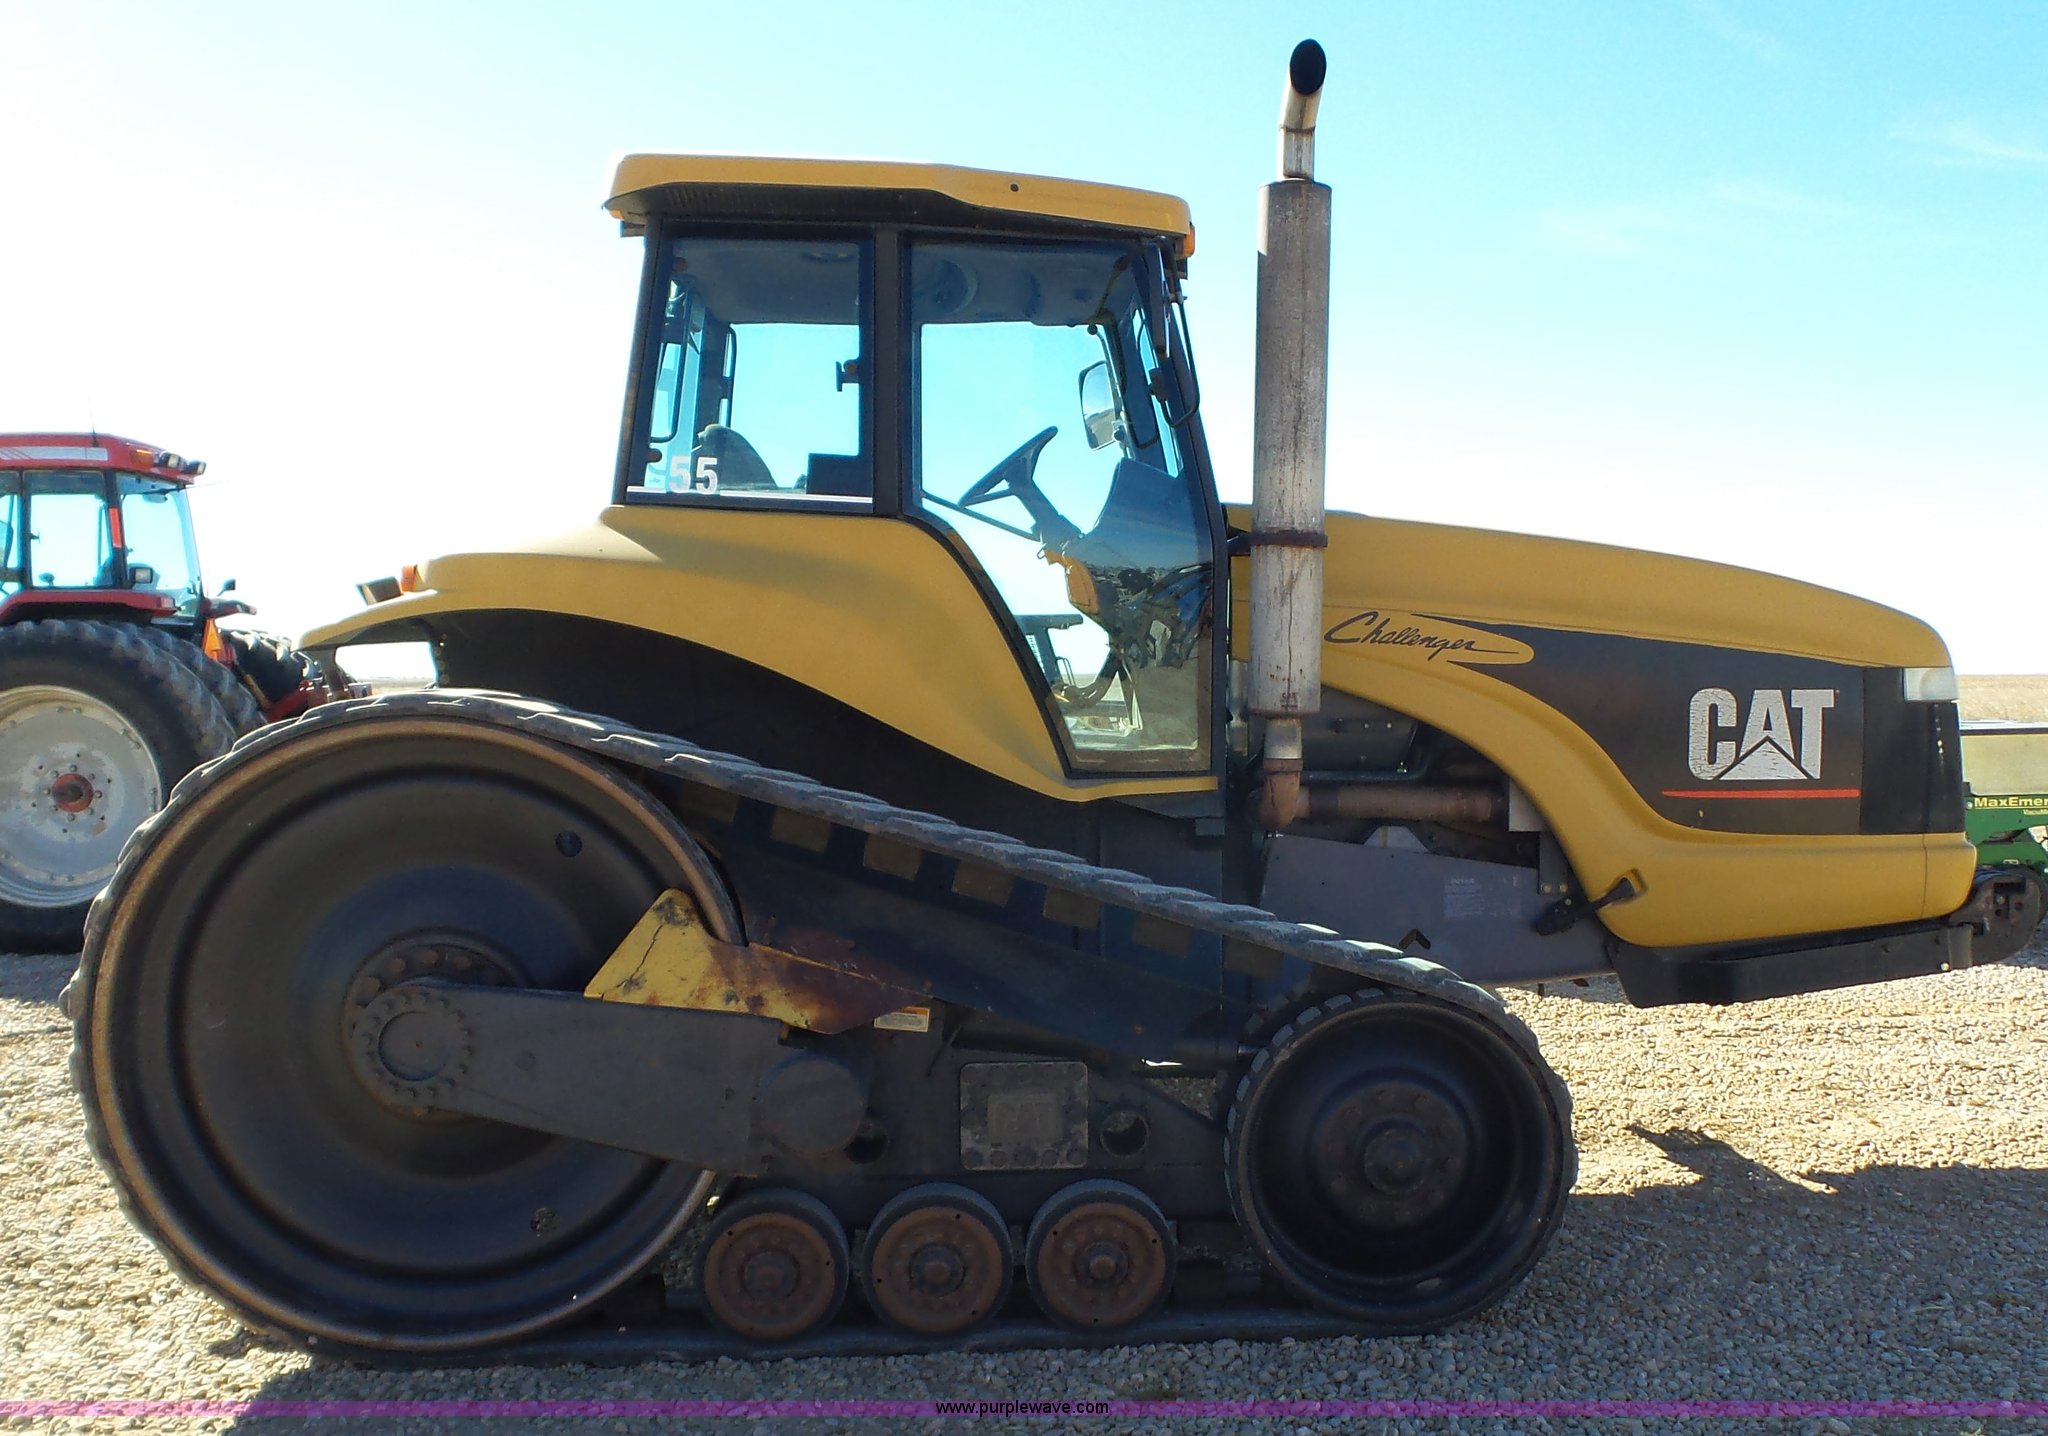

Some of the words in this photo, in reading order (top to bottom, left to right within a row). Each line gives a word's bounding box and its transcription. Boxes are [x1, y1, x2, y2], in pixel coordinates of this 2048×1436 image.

[669, 455, 718, 495] 55
[1323, 610, 1519, 661] Challenger
[1688, 687, 1835, 781] CAT
